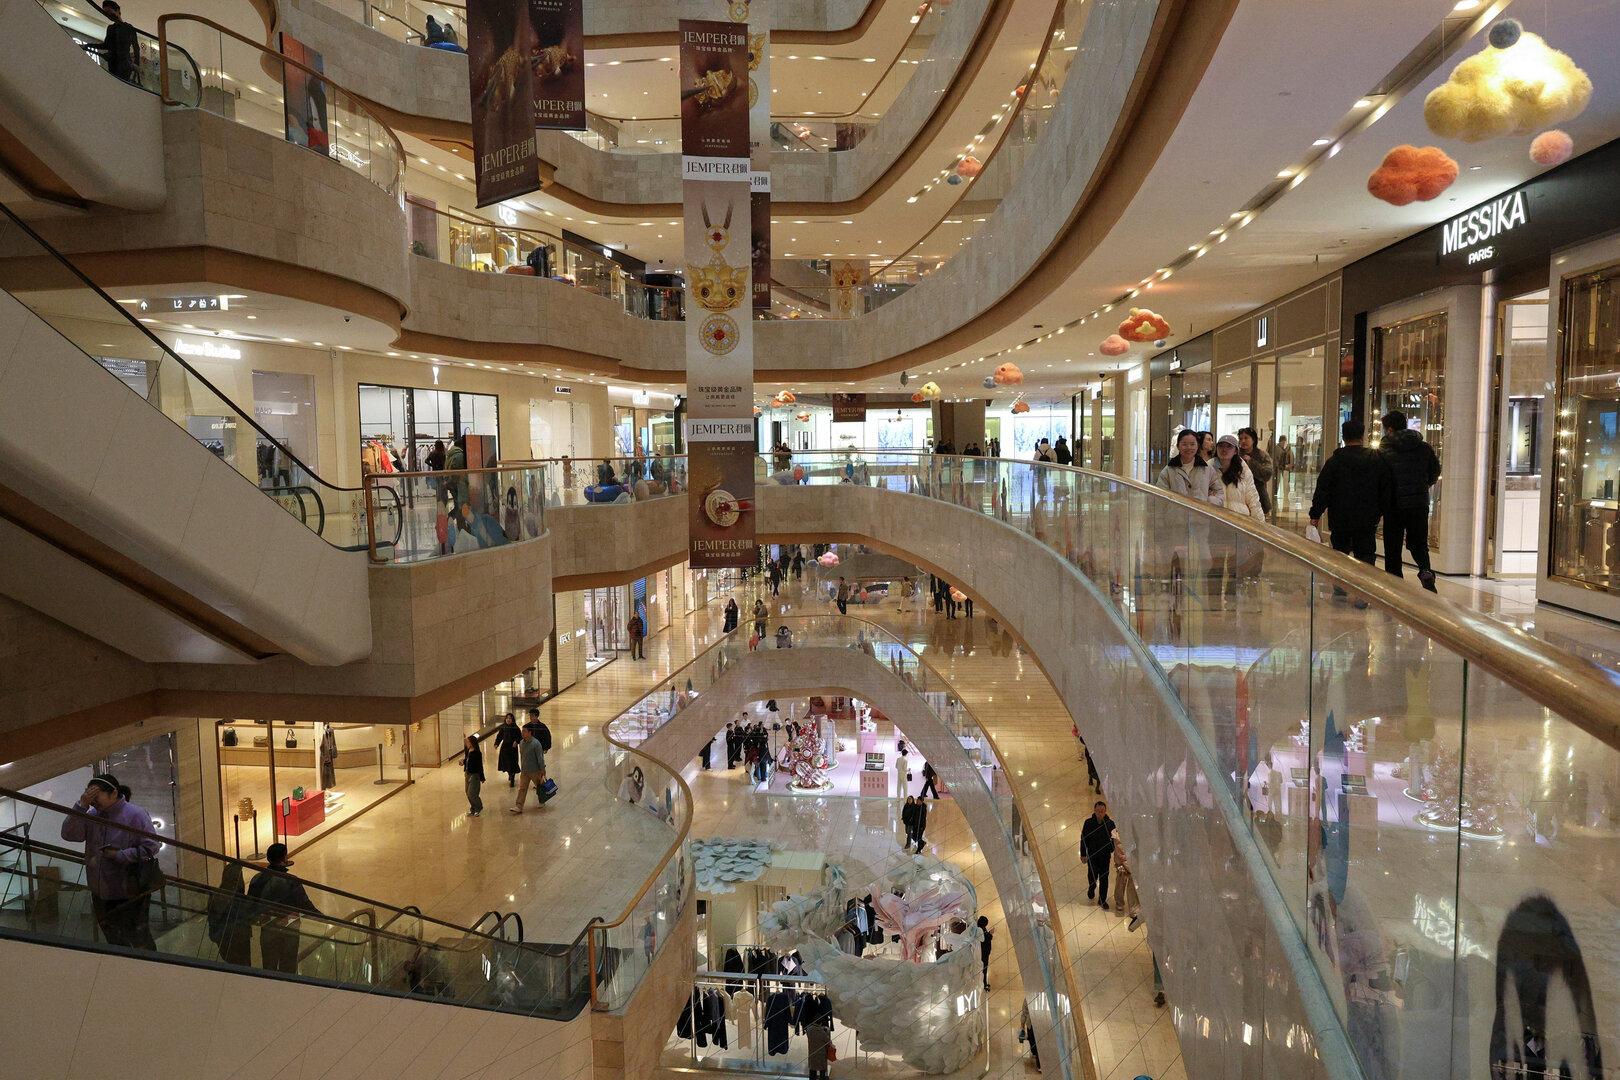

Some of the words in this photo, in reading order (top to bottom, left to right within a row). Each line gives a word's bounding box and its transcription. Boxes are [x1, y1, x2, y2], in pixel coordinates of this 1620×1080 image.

[1442, 191, 1526, 256] MESSIKA
[1468, 246, 1494, 265] PARIS
[173, 300, 183, 309] L2
